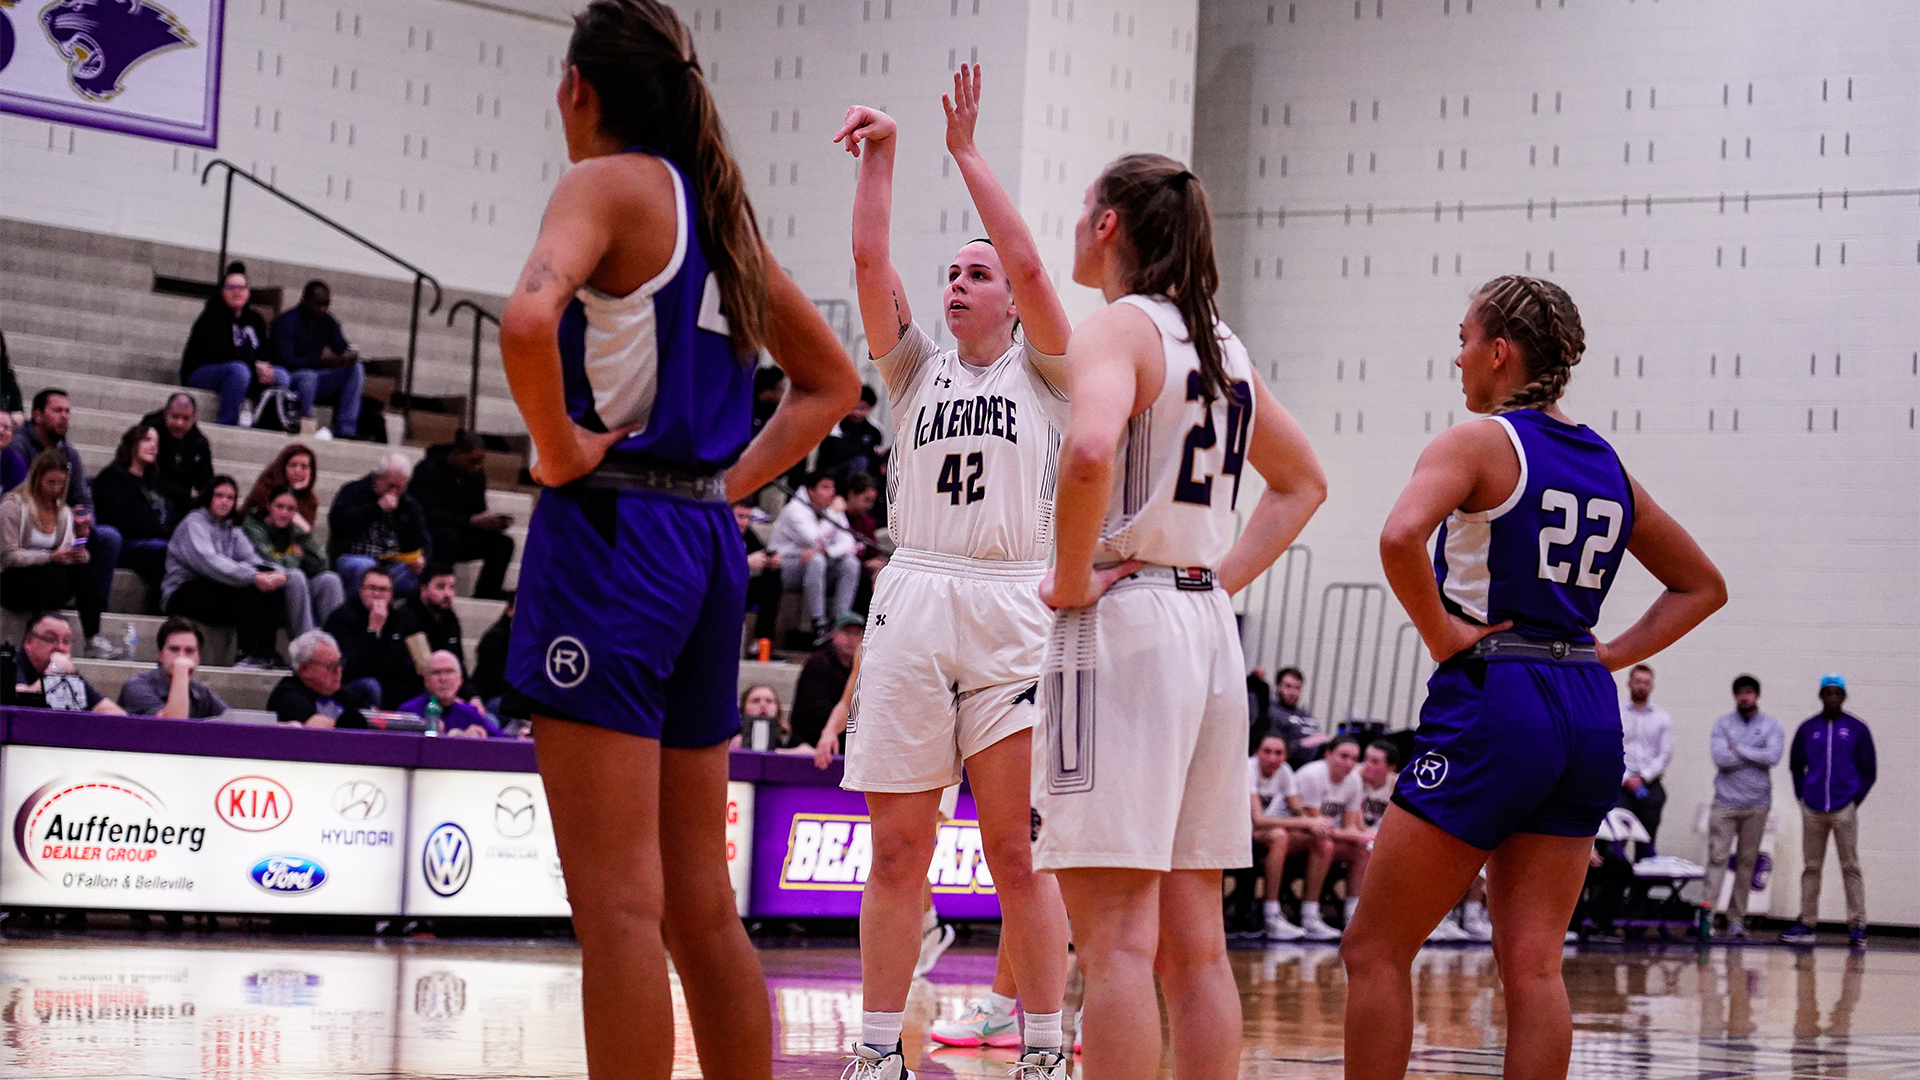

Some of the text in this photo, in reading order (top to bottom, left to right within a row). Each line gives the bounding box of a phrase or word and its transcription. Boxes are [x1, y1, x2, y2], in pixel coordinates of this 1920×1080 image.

[1173, 368, 1252, 512] 24
[937, 451, 985, 505] 42
[1538, 488, 1624, 590] 22
[229, 789, 279, 819] KIA
[44, 814, 206, 852] Auffenberg
[321, 829, 394, 847] HYUNDAI
[43, 845, 157, 863] DEALER GROUP
[63, 872, 194, 891] O'Fallon & Belleville
[261, 858, 317, 891] Ford
